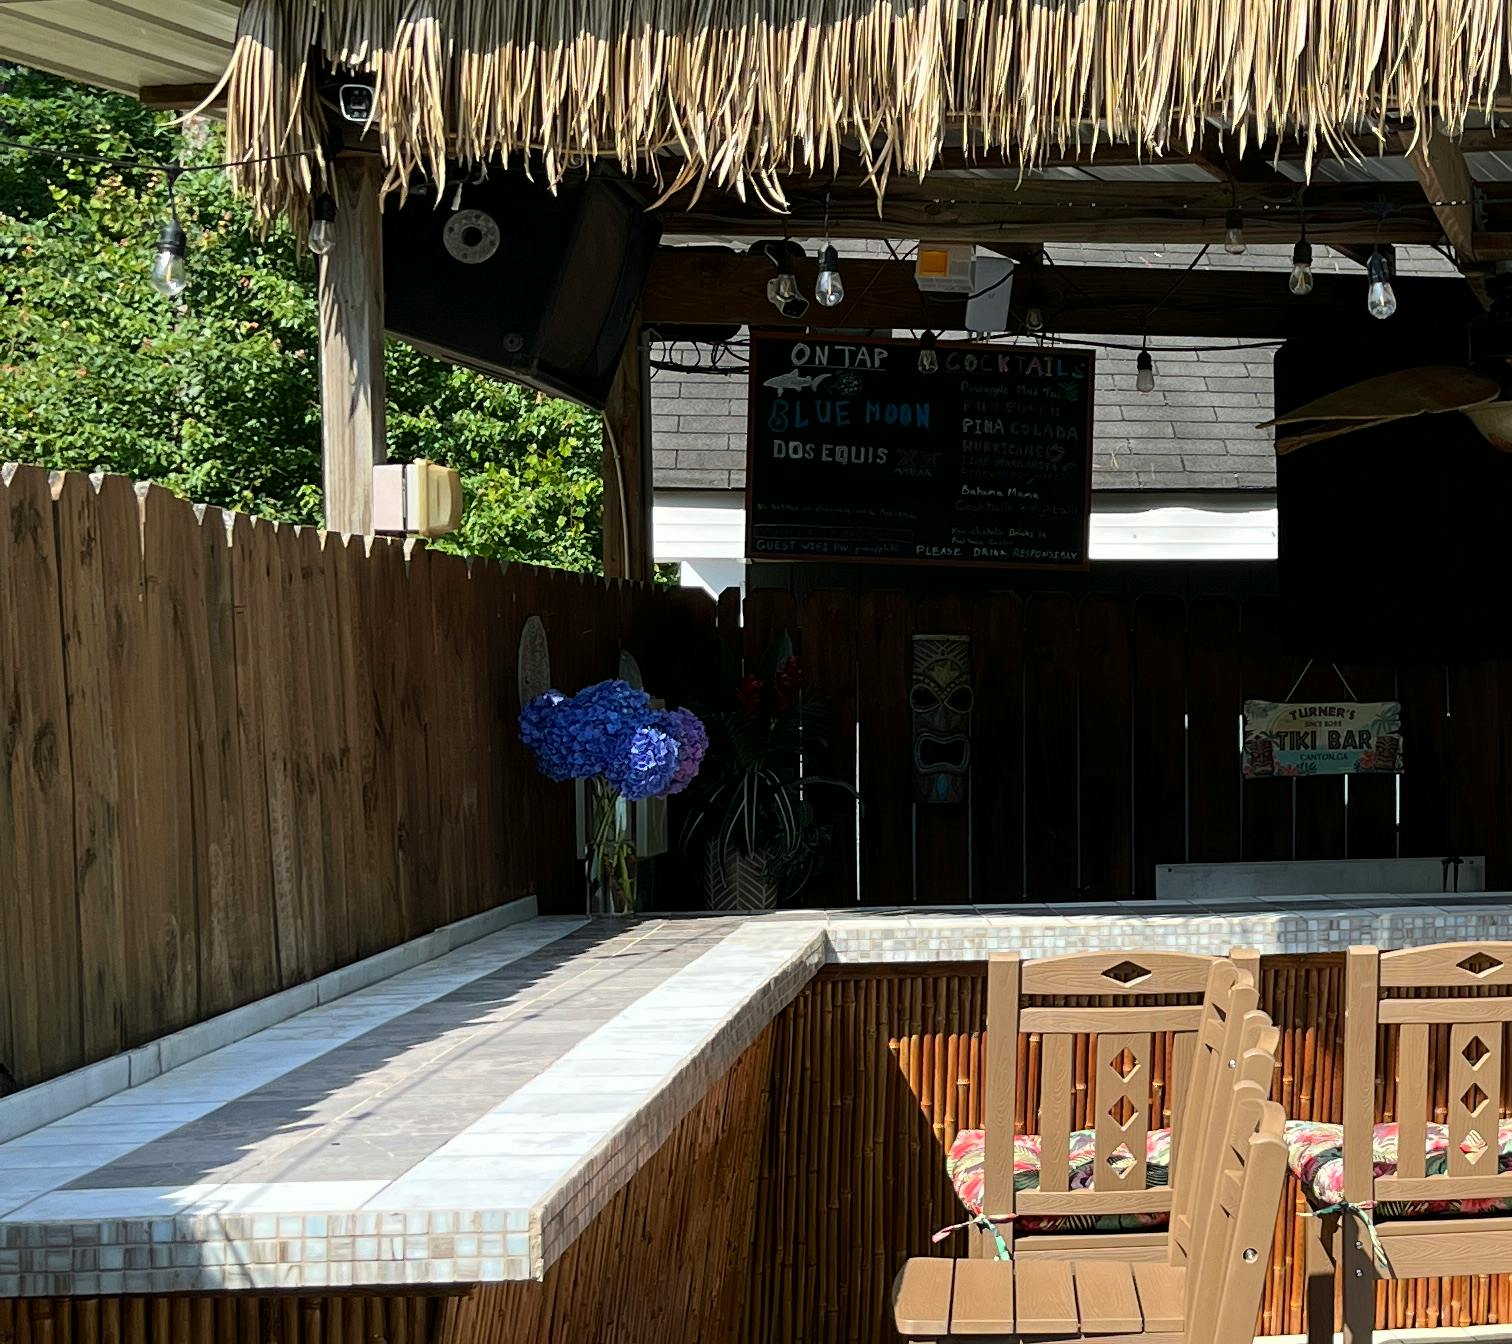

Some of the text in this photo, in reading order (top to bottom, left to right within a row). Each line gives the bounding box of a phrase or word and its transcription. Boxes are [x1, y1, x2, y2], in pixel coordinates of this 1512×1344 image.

[791, 342, 889, 369] ON TAP
[768, 399, 931, 433] BLUE MOON
[1009, 422, 1079, 441] COLADA
[773, 439, 816, 460] DOS
[821, 444, 889, 466] EQUIS
[962, 440, 1045, 458] HURRICANE
[961, 485, 1040, 500] Bahama Mama
[756, 539, 796, 552] GUEST
[915, 544, 1078, 560] PLEASE DRINK RESPONSIBLY
[1288, 706, 1356, 721] TURNER'S
[1277, 729, 1372, 751] TIKI BAR
